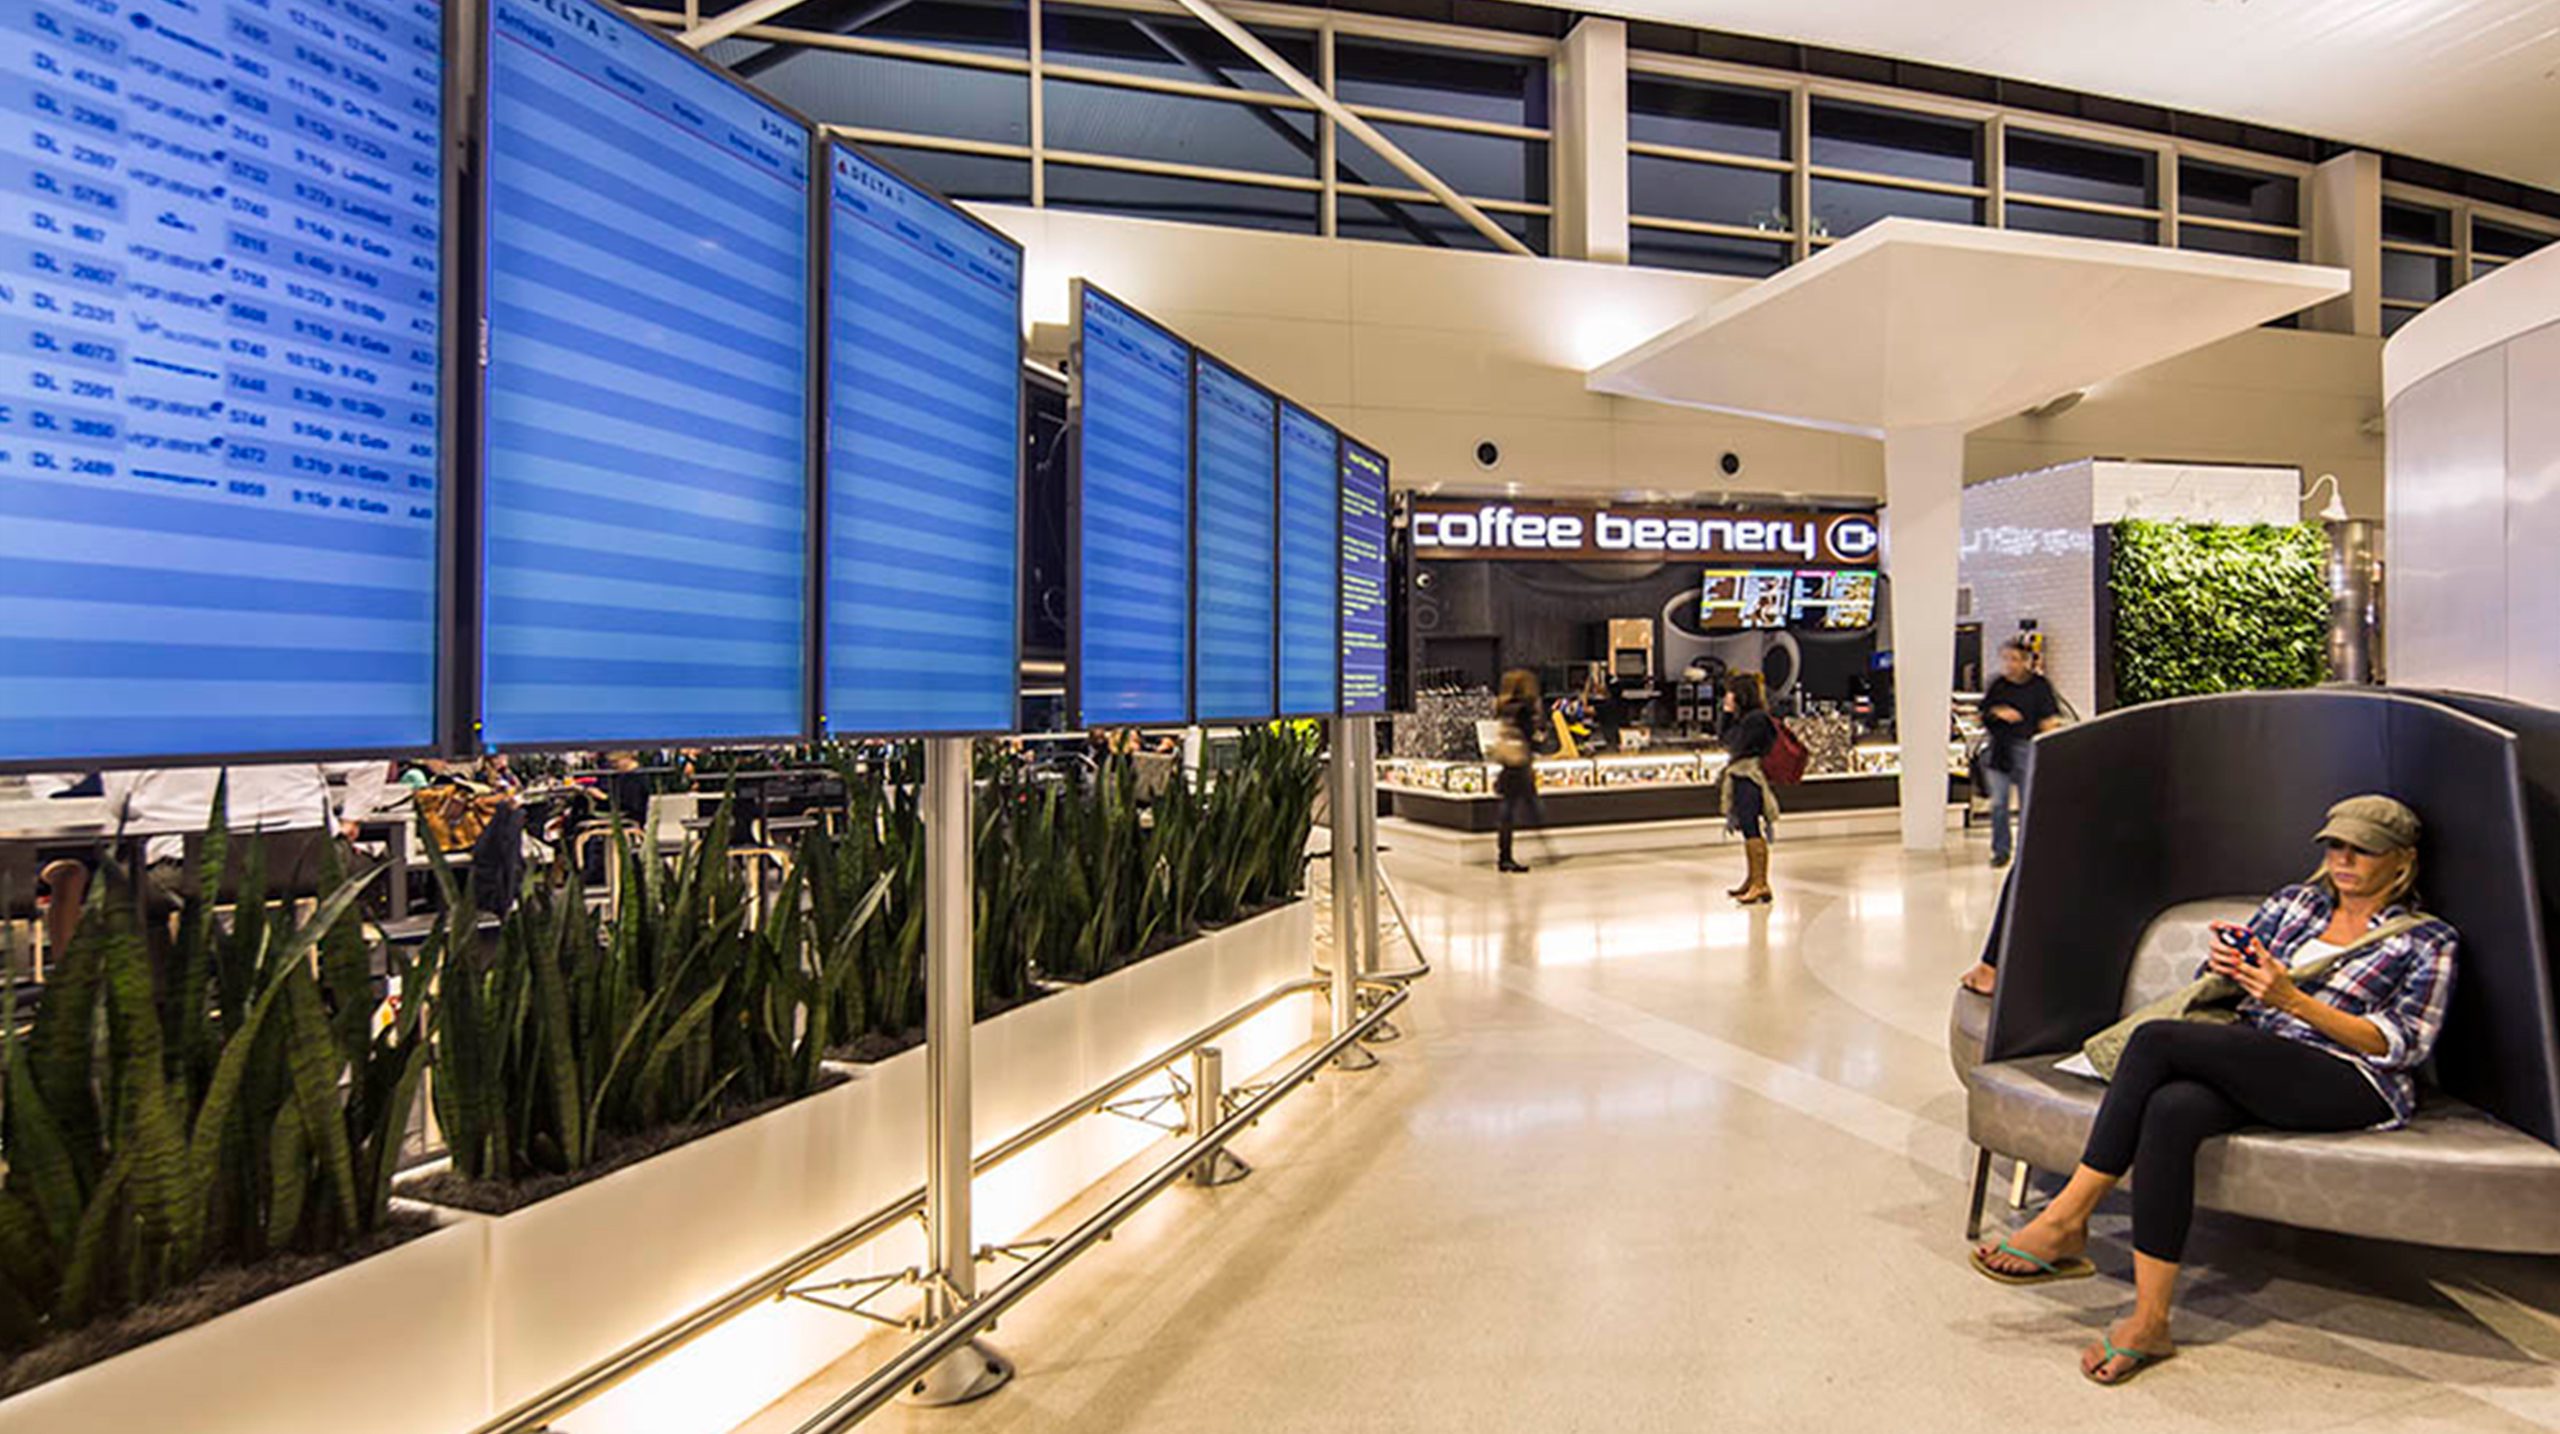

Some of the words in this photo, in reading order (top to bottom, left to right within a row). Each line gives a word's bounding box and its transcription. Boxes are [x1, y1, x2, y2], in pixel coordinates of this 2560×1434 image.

[529, 0, 599, 37] ELTA
[34, 51, 62, 76] DL
[33, 92, 62, 115] DL
[33, 131, 61, 154] DL
[33, 171, 61, 194] DL
[851, 164, 893, 199] DELTA
[33, 212, 61, 233] DL
[32, 251, 60, 273] DL
[32, 292, 60, 312] DL
[32, 331, 60, 352] DL
[32, 371, 59, 391] DL
[31, 411, 59, 431] DL
[32, 451, 59, 470] DL
[1413, 505, 1582, 549] coffee
[1595, 511, 1816, 561] beanery
